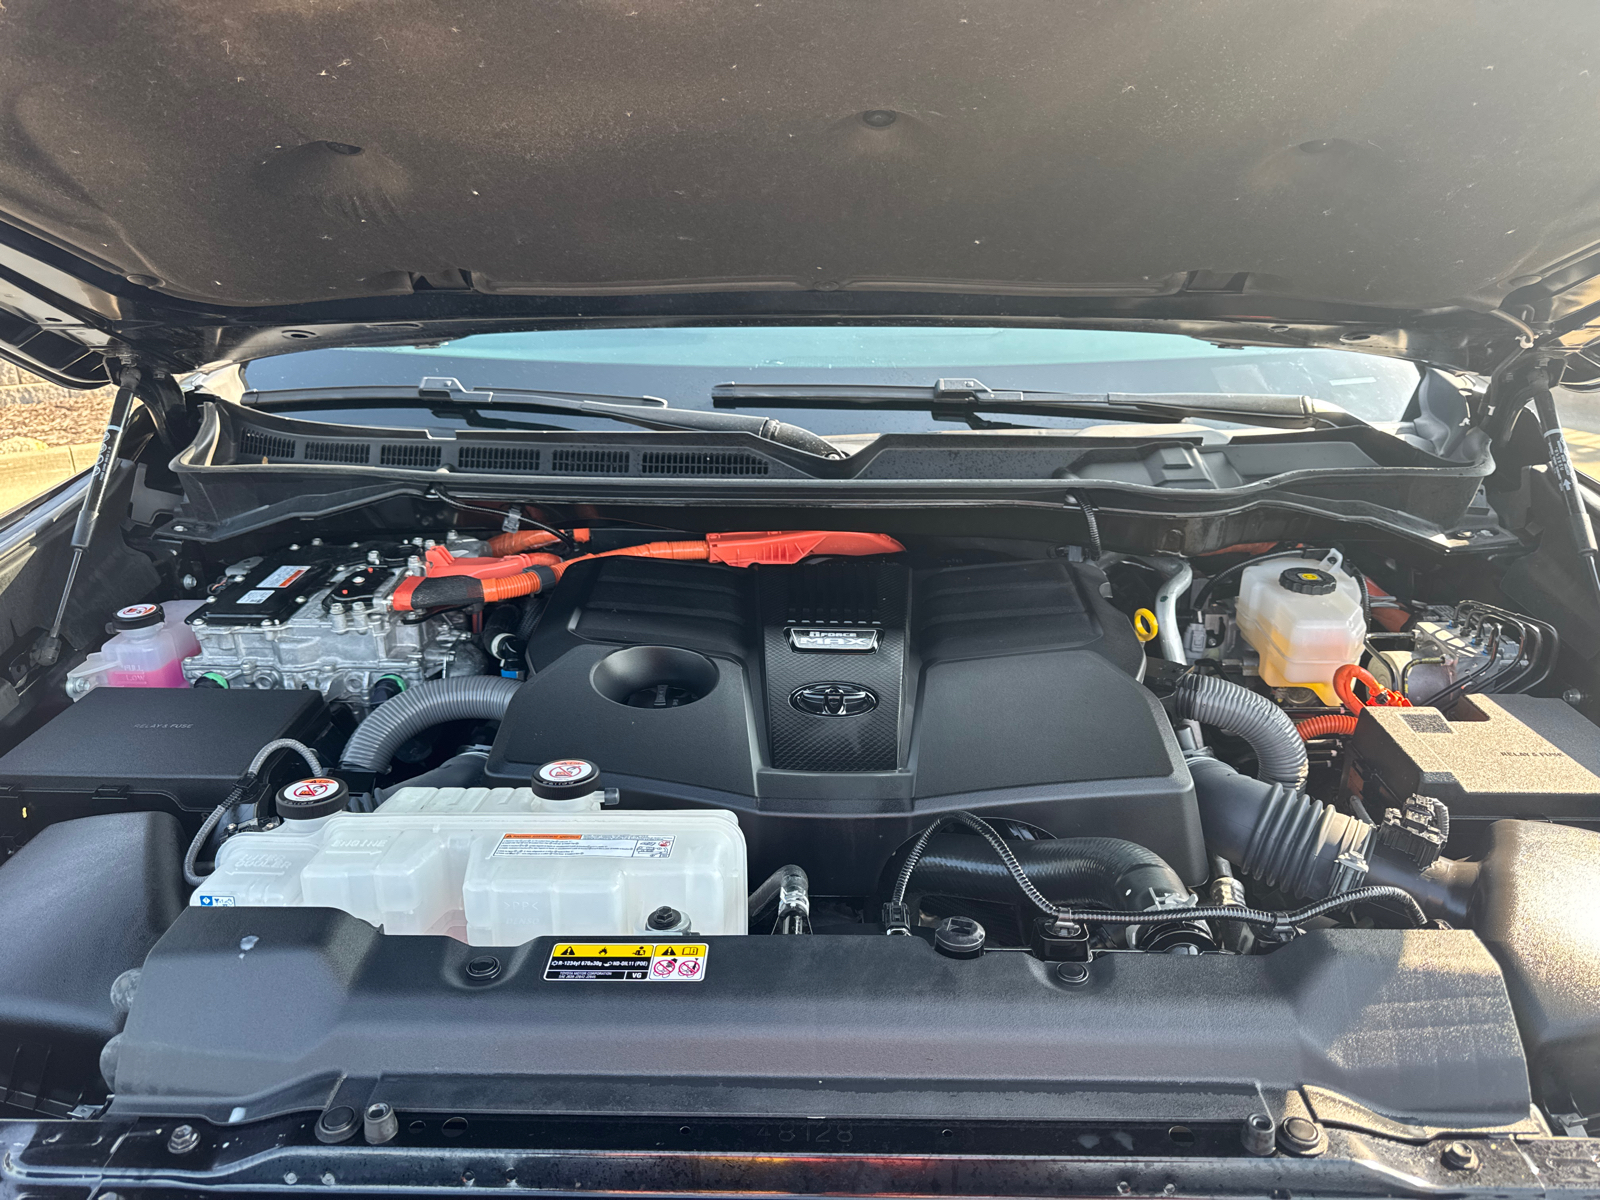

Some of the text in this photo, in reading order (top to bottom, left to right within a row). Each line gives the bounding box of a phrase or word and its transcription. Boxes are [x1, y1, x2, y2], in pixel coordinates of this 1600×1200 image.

[800, 637, 867, 645] MAX
[331, 839, 388, 847] ENGINE
[757, 1120, 853, 1142] 48128
